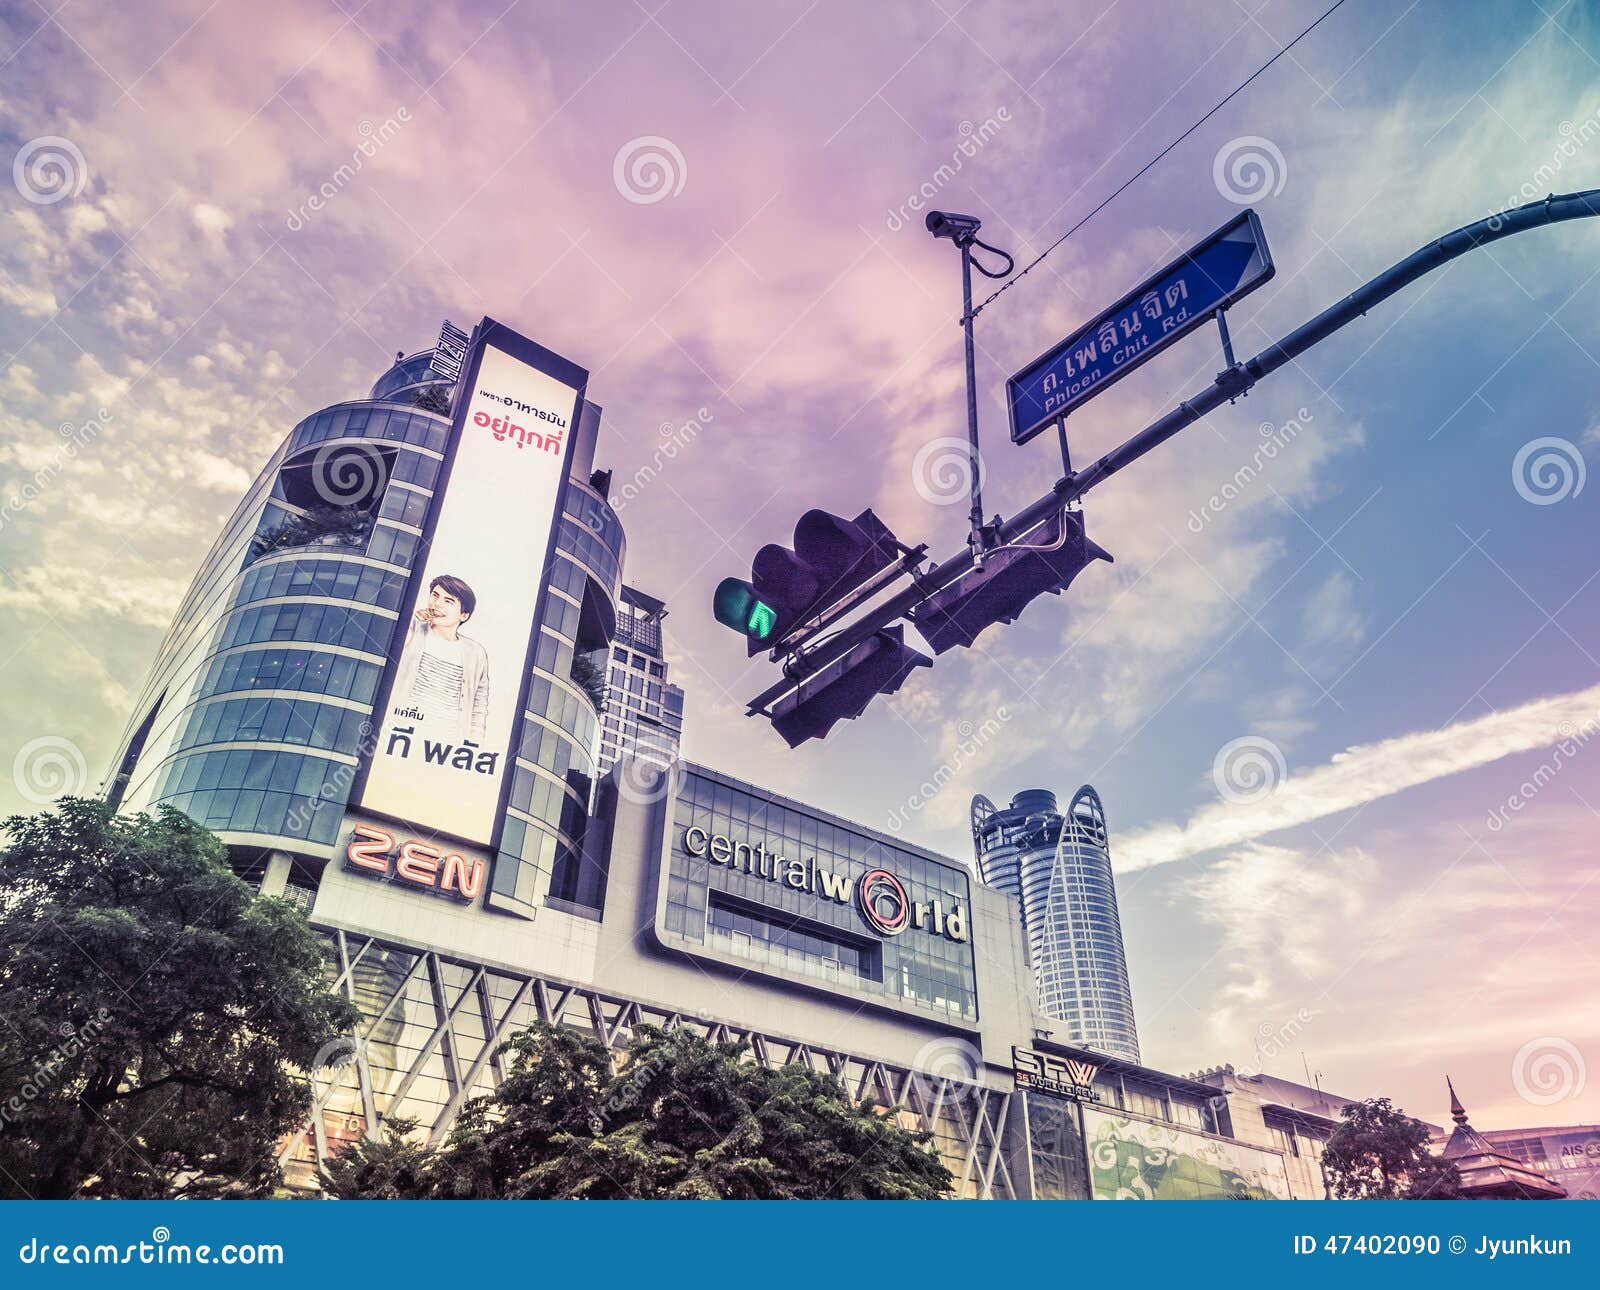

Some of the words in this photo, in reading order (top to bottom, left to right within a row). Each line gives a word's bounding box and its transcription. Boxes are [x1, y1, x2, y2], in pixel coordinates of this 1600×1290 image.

[1044, 368, 1101, 413] Phloen
[1112, 334, 1149, 365] Chit
[1162, 307, 1192, 332] Rd.
[473, 411, 563, 456] อยู่ทุกที่
[348, 823, 485, 899] ZEN
[1562, 1144, 1583, 1156] AIS
